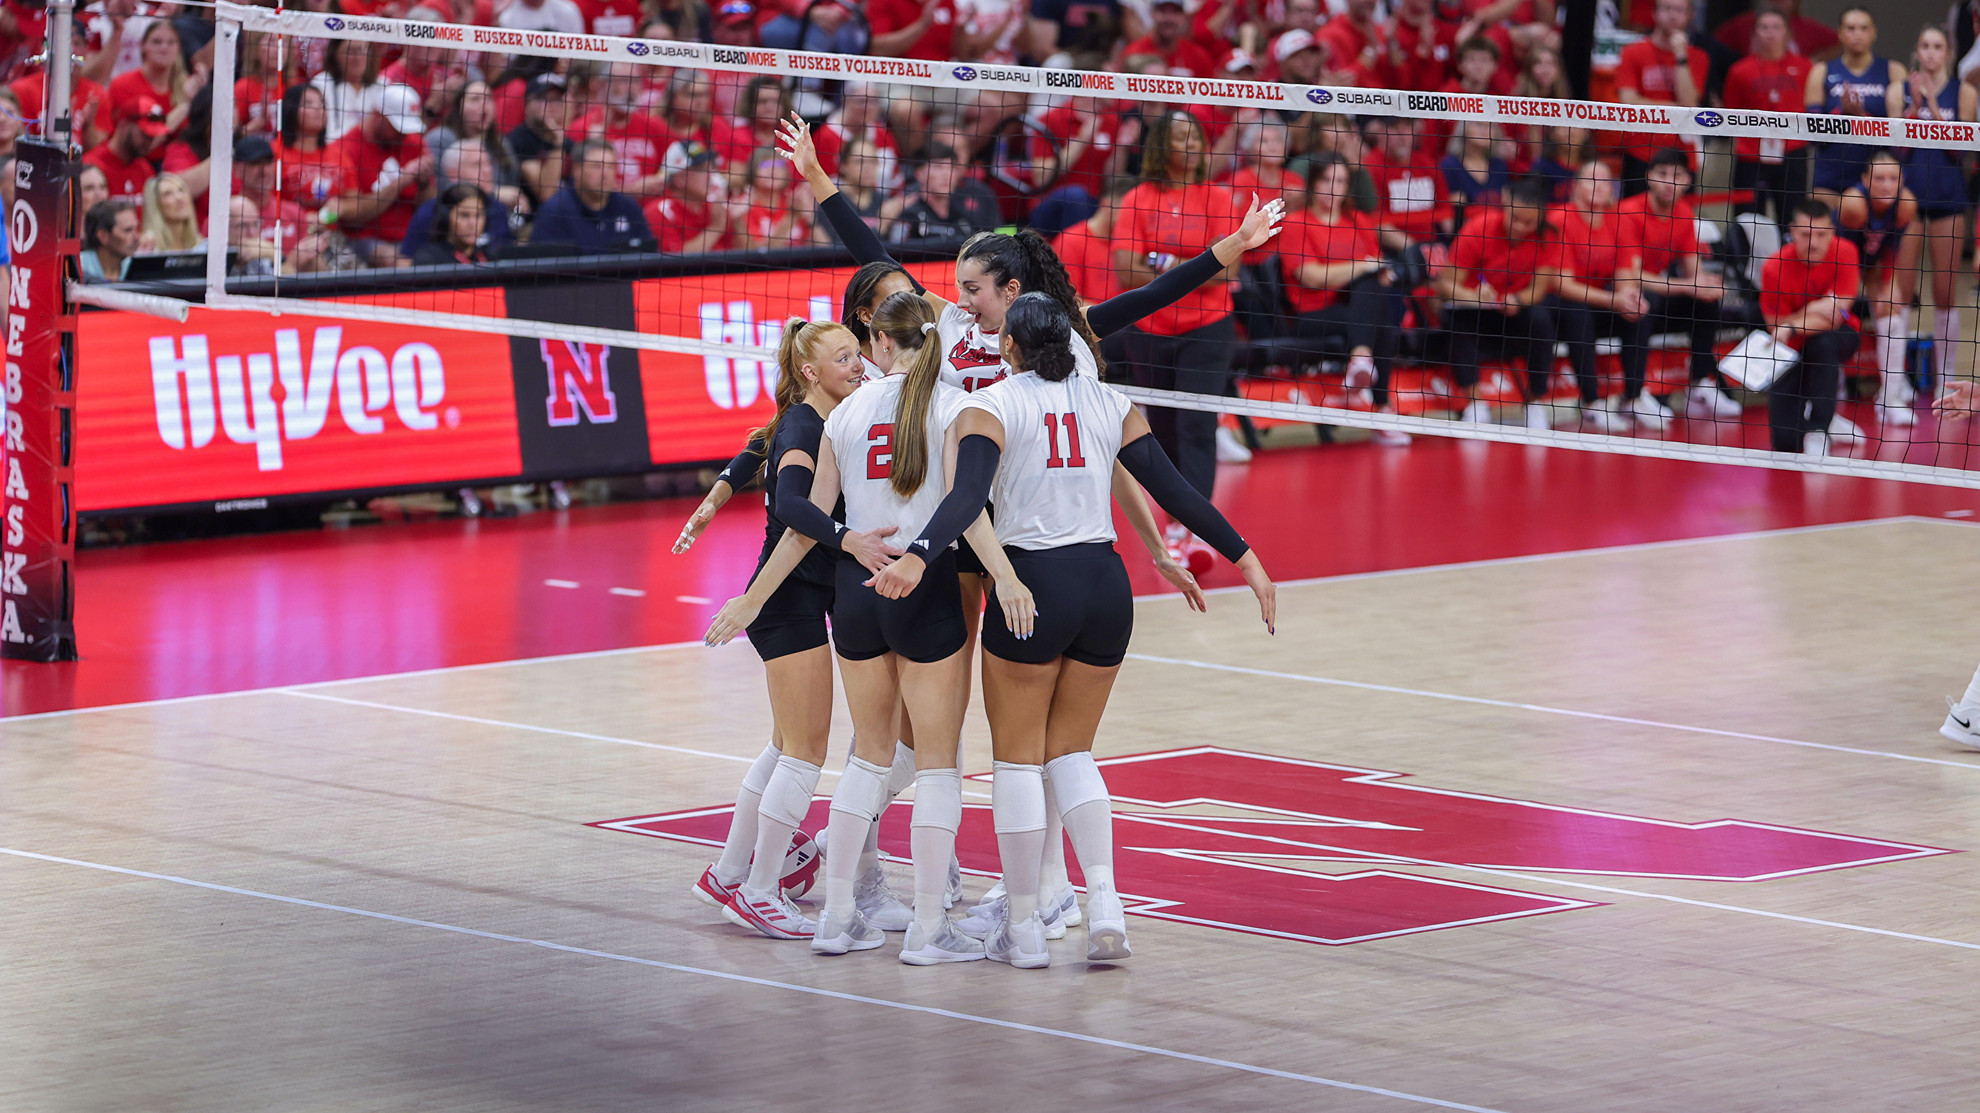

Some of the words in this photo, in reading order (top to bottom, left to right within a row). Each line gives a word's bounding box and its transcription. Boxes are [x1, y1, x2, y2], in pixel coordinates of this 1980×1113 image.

[347, 21, 392, 33] SUBARU
[404, 24, 464, 41] BEARDMORE
[474, 30, 523, 46] HUSKER
[526, 34, 608, 52] VOLLEYBALL
[652, 45, 699, 58] SUBARU
[714, 49, 777, 67] BEARDMORE
[788, 54, 841, 72] HUSKER
[844, 58, 932, 78] VOLLEYBALL
[980, 70, 1031, 82] SUBARU
[1046, 72, 1115, 90] BEARDMORE
[1127, 77, 1186, 95] HUSKER
[1188, 81, 1284, 101] VOLLEYBALL
[1336, 92, 1392, 105] SUBARU
[1408, 95, 1484, 113] BEARDMORE
[1497, 99, 1562, 118] HUSKER
[1564, 103, 1671, 124] VOLLEYBALL
[1727, 115, 1789, 128] SUBARU
[1806, 117, 1890, 137] BEARDMORE
[1905, 123, 1975, 142] HUSKER
[540, 335, 617, 427] N
[148, 326, 446, 471] HyVee
[867, 423, 896, 480] 2
[1044, 412, 1086, 468] 11
